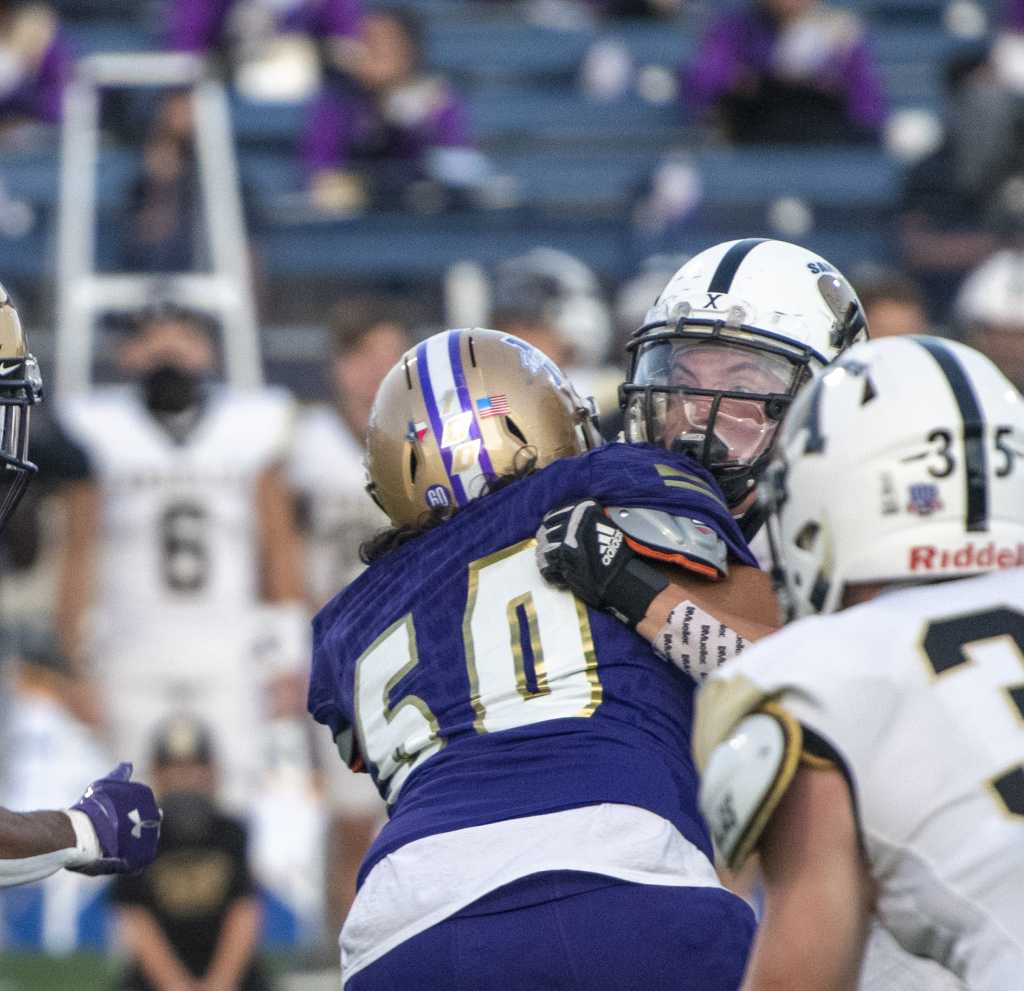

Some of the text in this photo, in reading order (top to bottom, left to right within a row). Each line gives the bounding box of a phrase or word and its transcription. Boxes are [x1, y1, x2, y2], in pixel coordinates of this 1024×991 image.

[704, 293, 723, 310] X
[426, 486, 450, 507] 60
[156, 499, 212, 595] 6
[601, 529, 625, 566] adidas
[355, 537, 603, 806] 60
